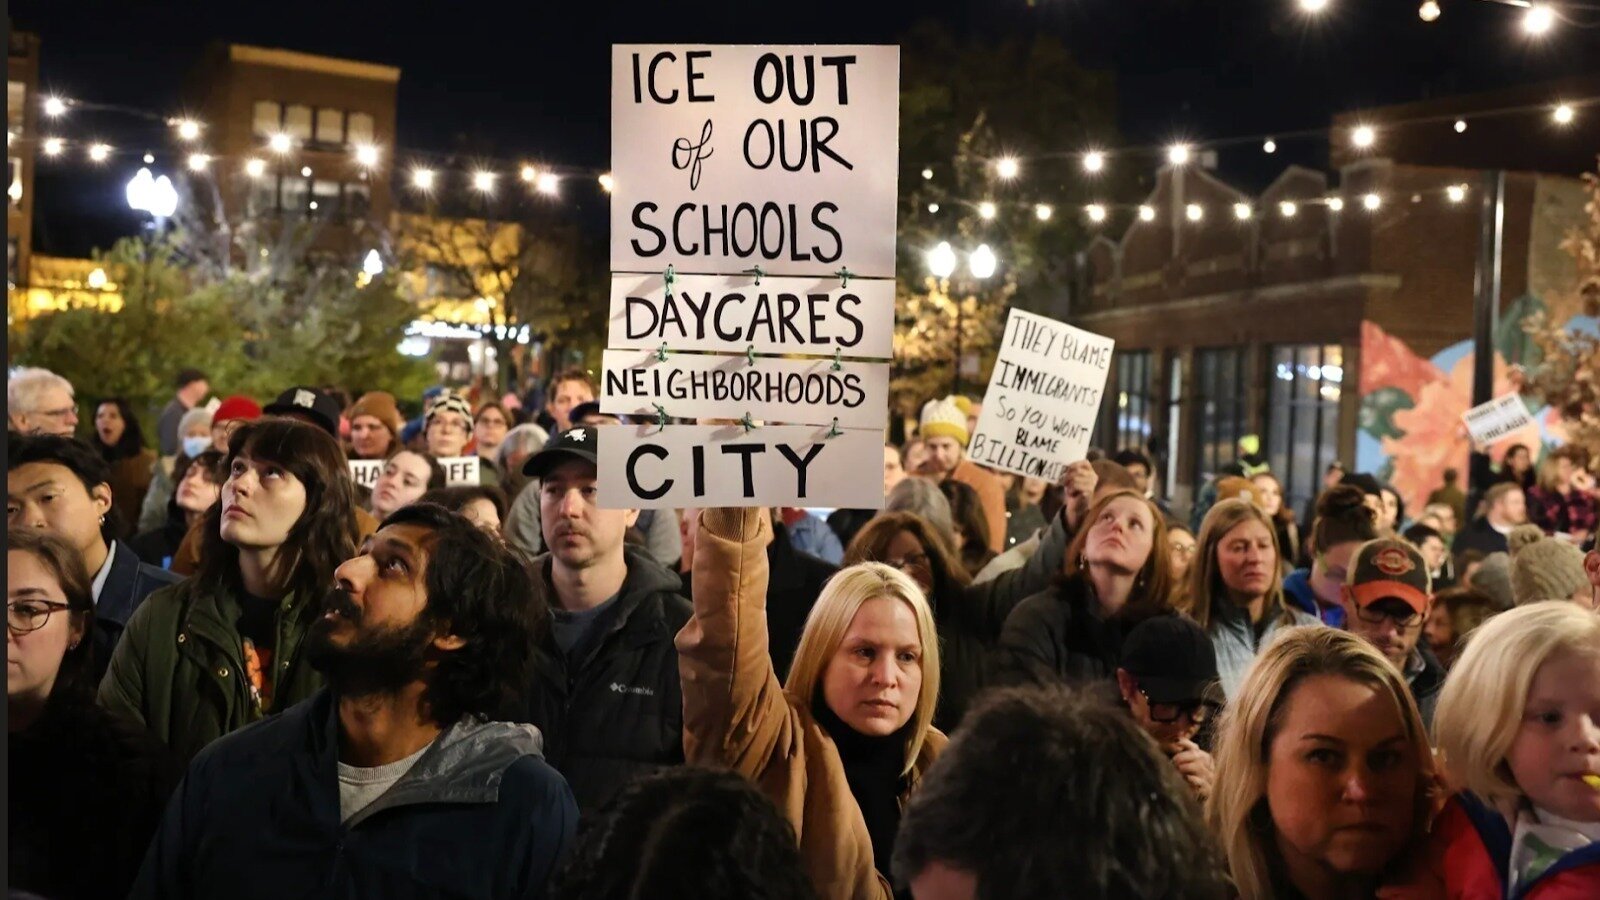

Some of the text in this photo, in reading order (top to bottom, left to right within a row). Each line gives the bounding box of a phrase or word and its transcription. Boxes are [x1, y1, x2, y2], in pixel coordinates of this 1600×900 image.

[631, 50, 857, 106] ICE OUT
[671, 116, 854, 191] of OUR
[630, 201, 843, 264] SCHOOLS
[625, 291, 864, 348] DAYCARES
[1011, 315, 1111, 370] THEY BLAME
[606, 368, 866, 408] NEIGHBORHOODS
[1015, 428, 1062, 453] BLAME
[1021, 404, 1048, 429] YOU
[444, 463, 473, 481] FF
[625, 443, 826, 500] CITY
